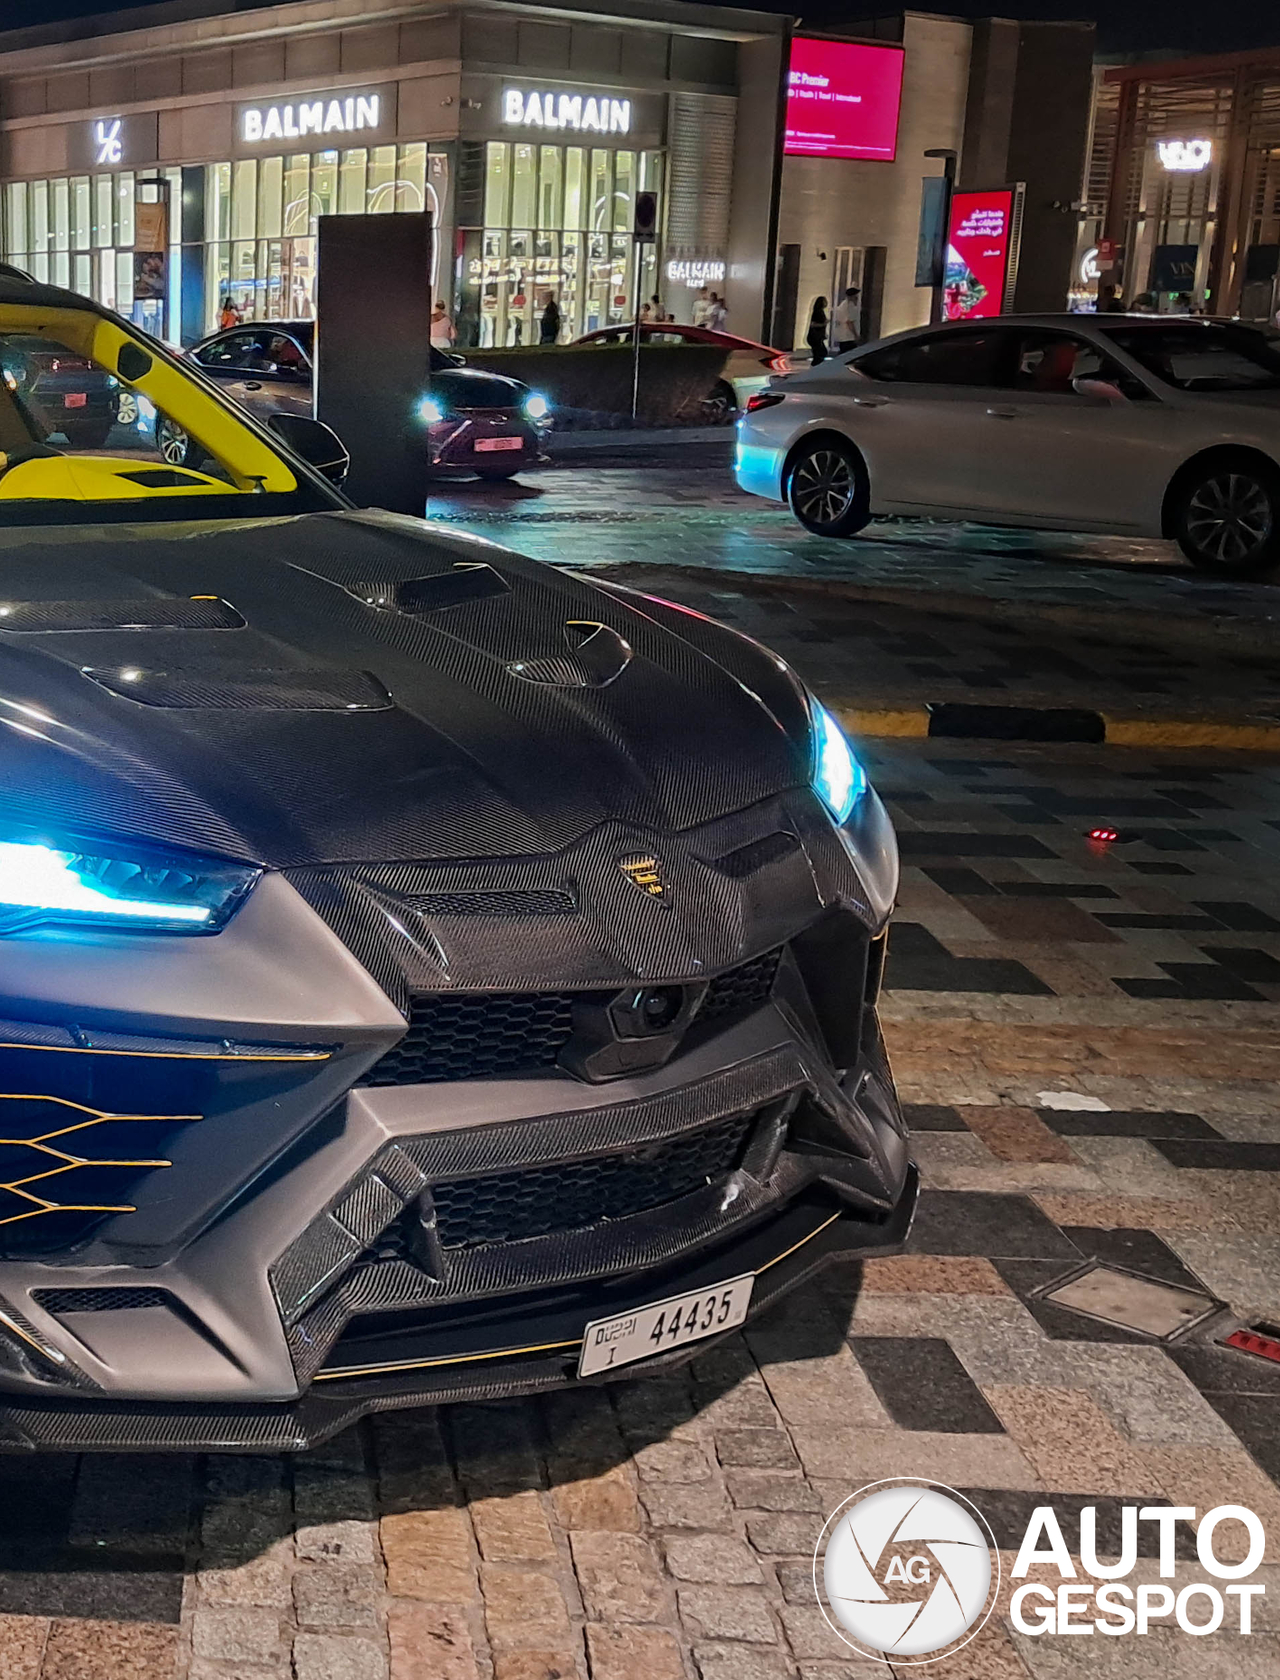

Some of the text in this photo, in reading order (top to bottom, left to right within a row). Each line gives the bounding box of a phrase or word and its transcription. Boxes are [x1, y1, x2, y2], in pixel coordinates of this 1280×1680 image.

[244, 94, 380, 141] BALMAIN
[504, 89, 631, 133] BALMAIN
[649, 1288, 735, 1346] 44435
